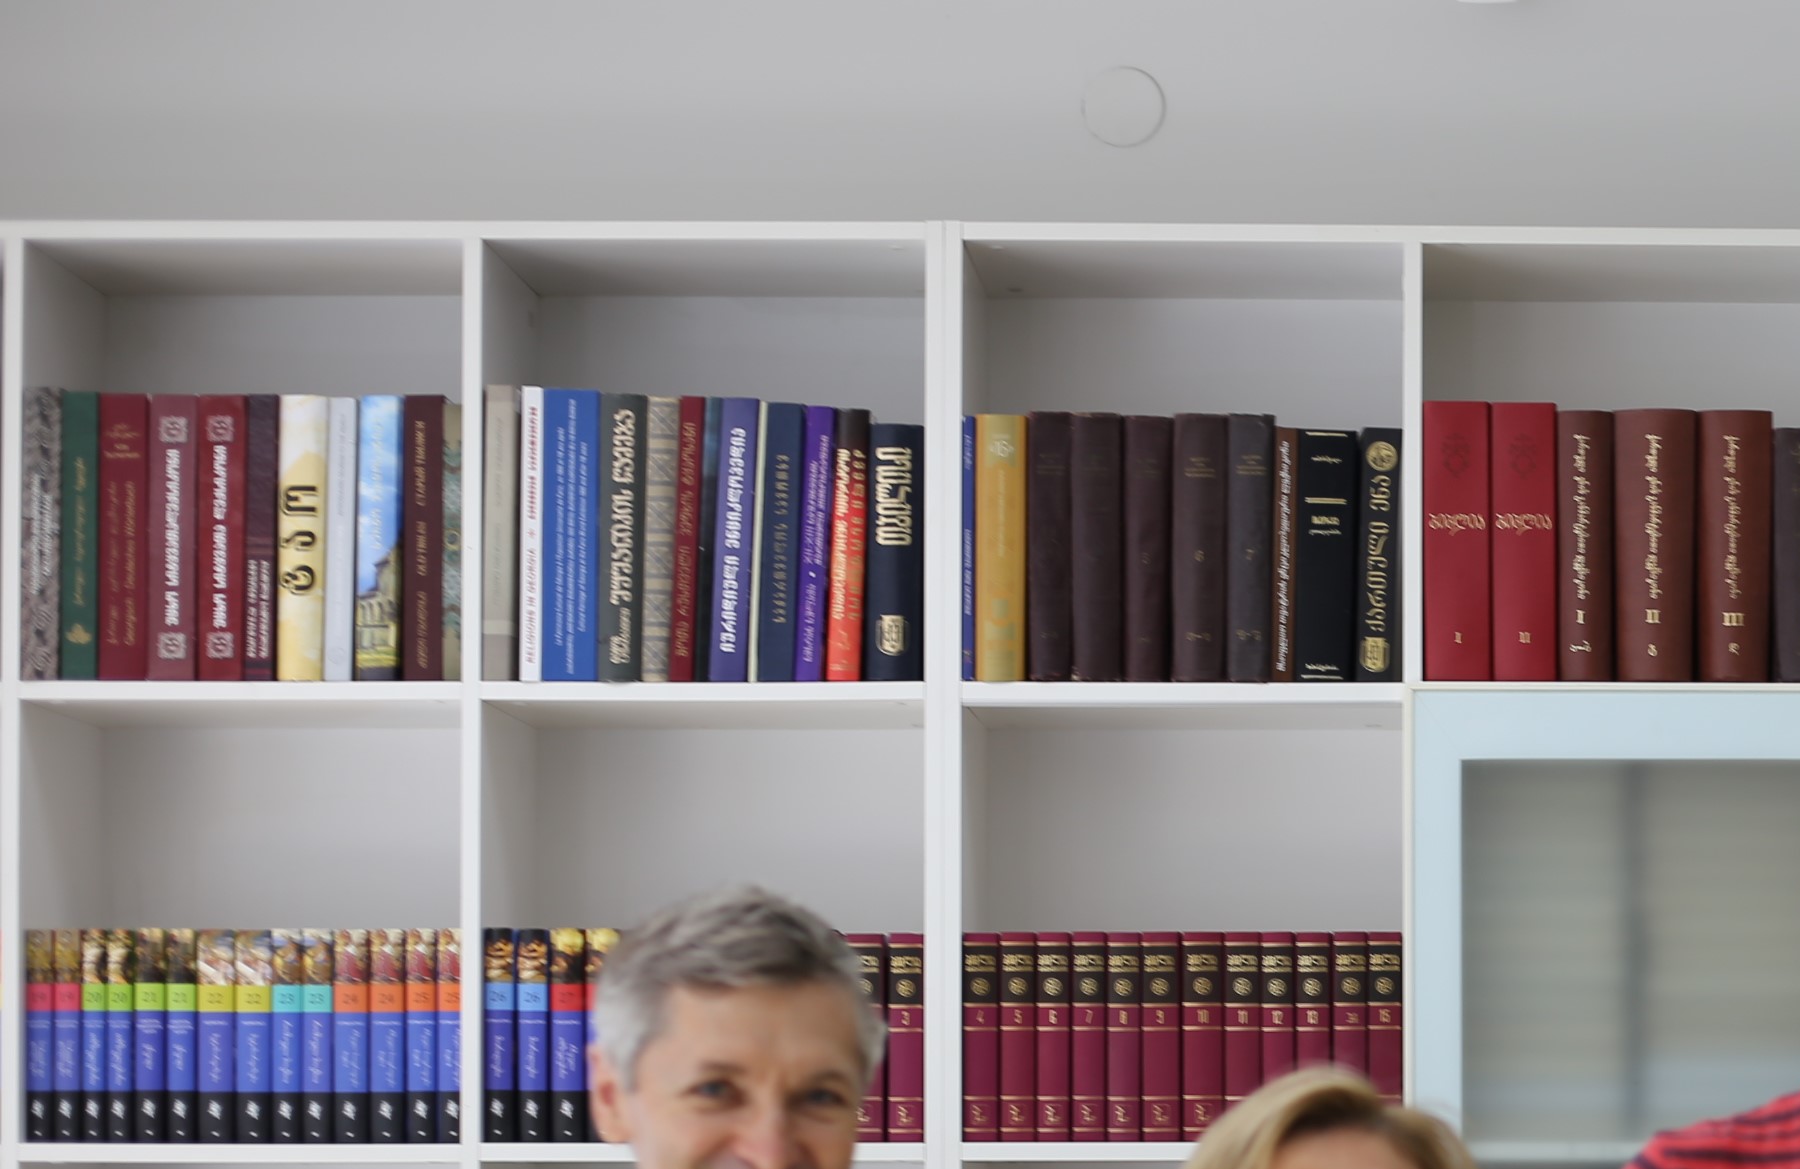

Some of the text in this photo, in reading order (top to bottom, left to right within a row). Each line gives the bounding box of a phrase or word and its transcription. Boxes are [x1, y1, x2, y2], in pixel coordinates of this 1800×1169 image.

[164, 448, 181, 626] უცხო სიტყვათა ლექსიკონი
[212, 445, 228, 628] უცხო სიტყვათა ლექსიკონი
[278, 484, 319, 596] ტაო
[720, 427, 747, 653] იურიდიული ენციკლოპედია
[1364, 473, 1391, 633] ქართული ენა
[1645, 609, 1661, 624] II
[1722, 612, 1744, 627] III
